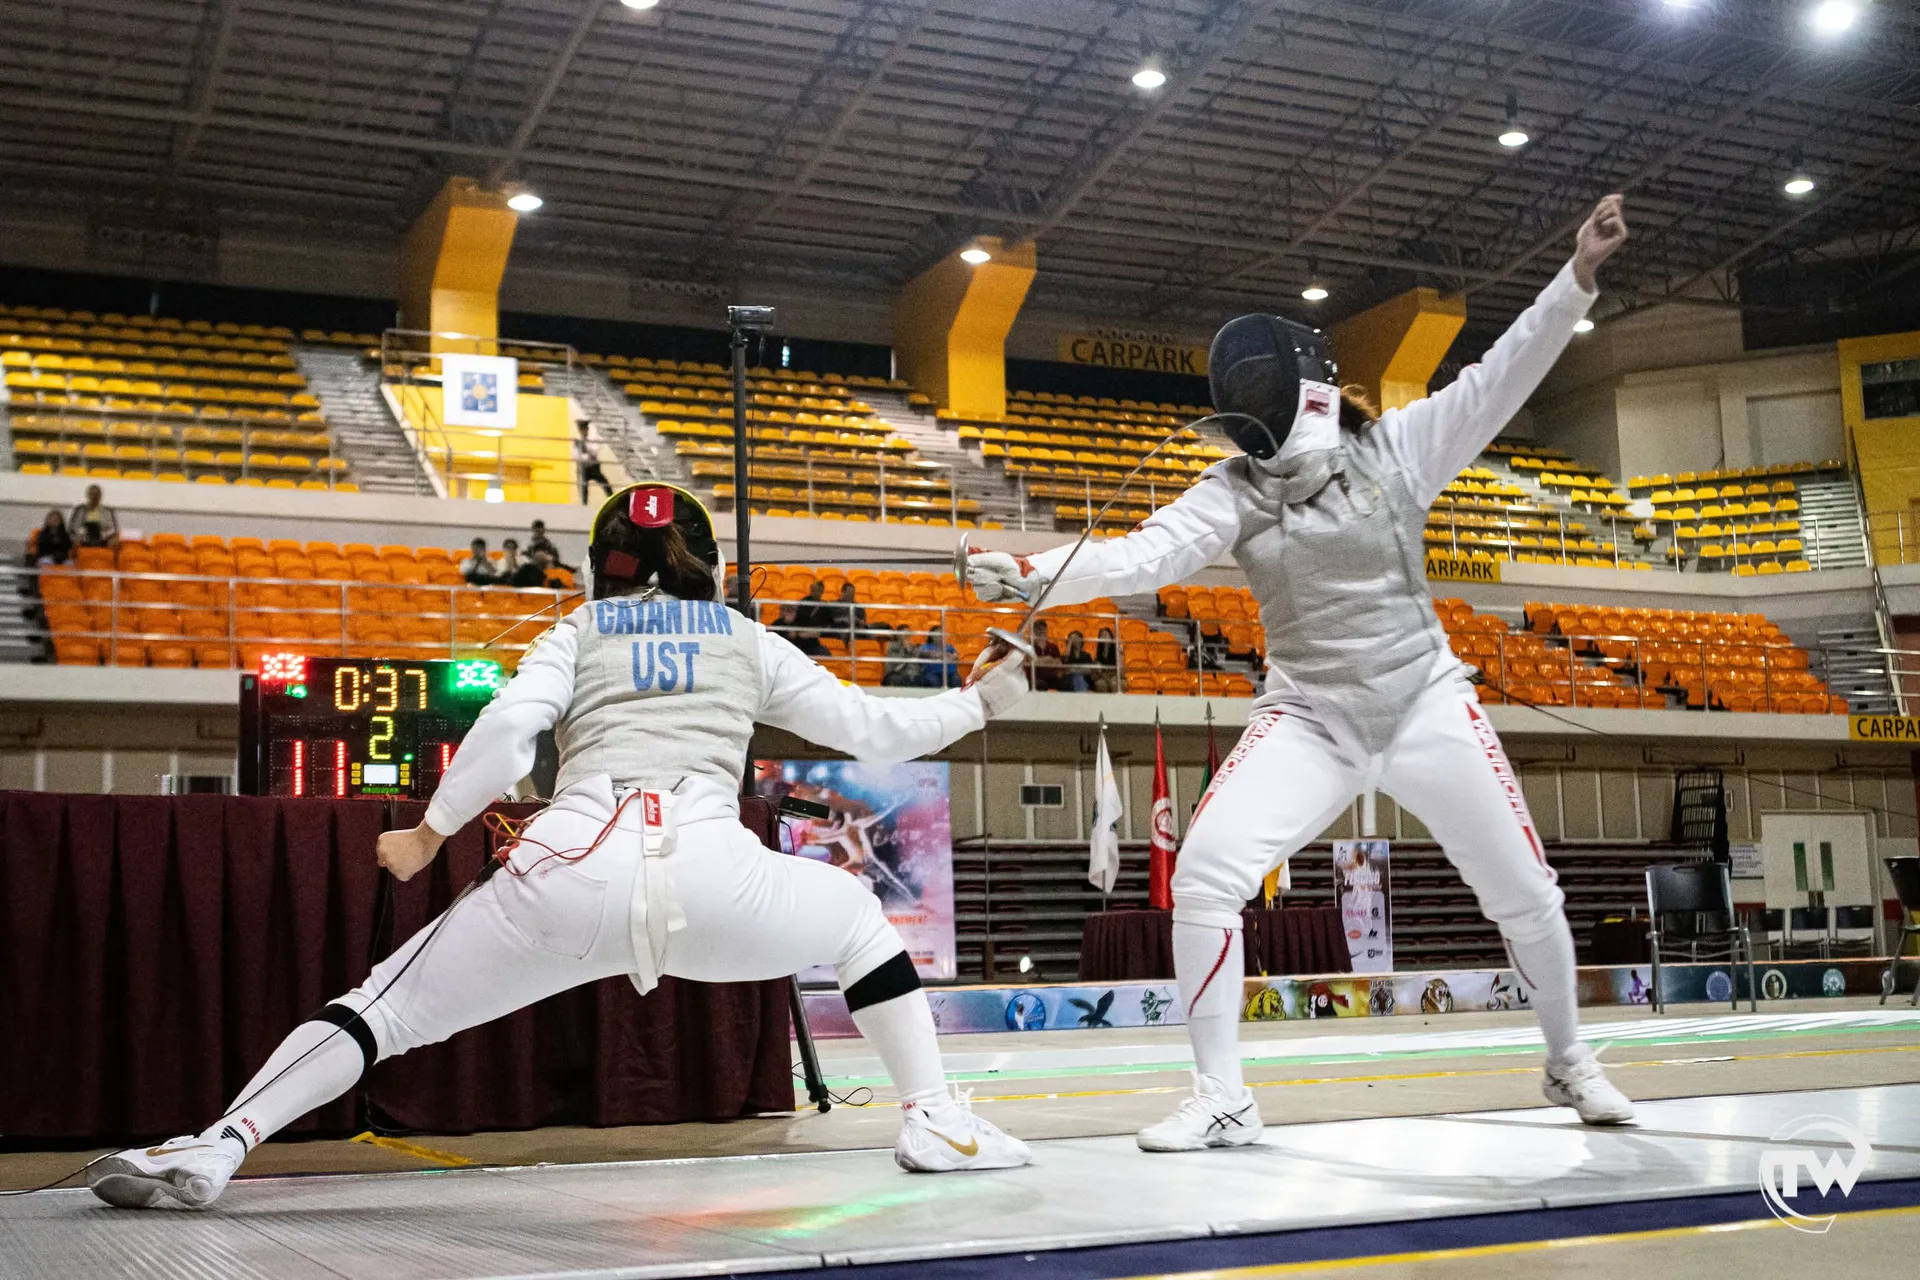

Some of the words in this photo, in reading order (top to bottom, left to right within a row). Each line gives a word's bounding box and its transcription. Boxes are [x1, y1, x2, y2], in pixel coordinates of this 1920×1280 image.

[1071, 339, 1196, 373] CARPARK
[1426, 559, 1493, 579] ARPARK
[632, 641, 700, 693] UST
[335, 667, 427, 711] 0:37
[369, 716, 393, 759] 2
[1857, 718, 1920, 738] CARPA
[241, 1117, 260, 1143] allsta
